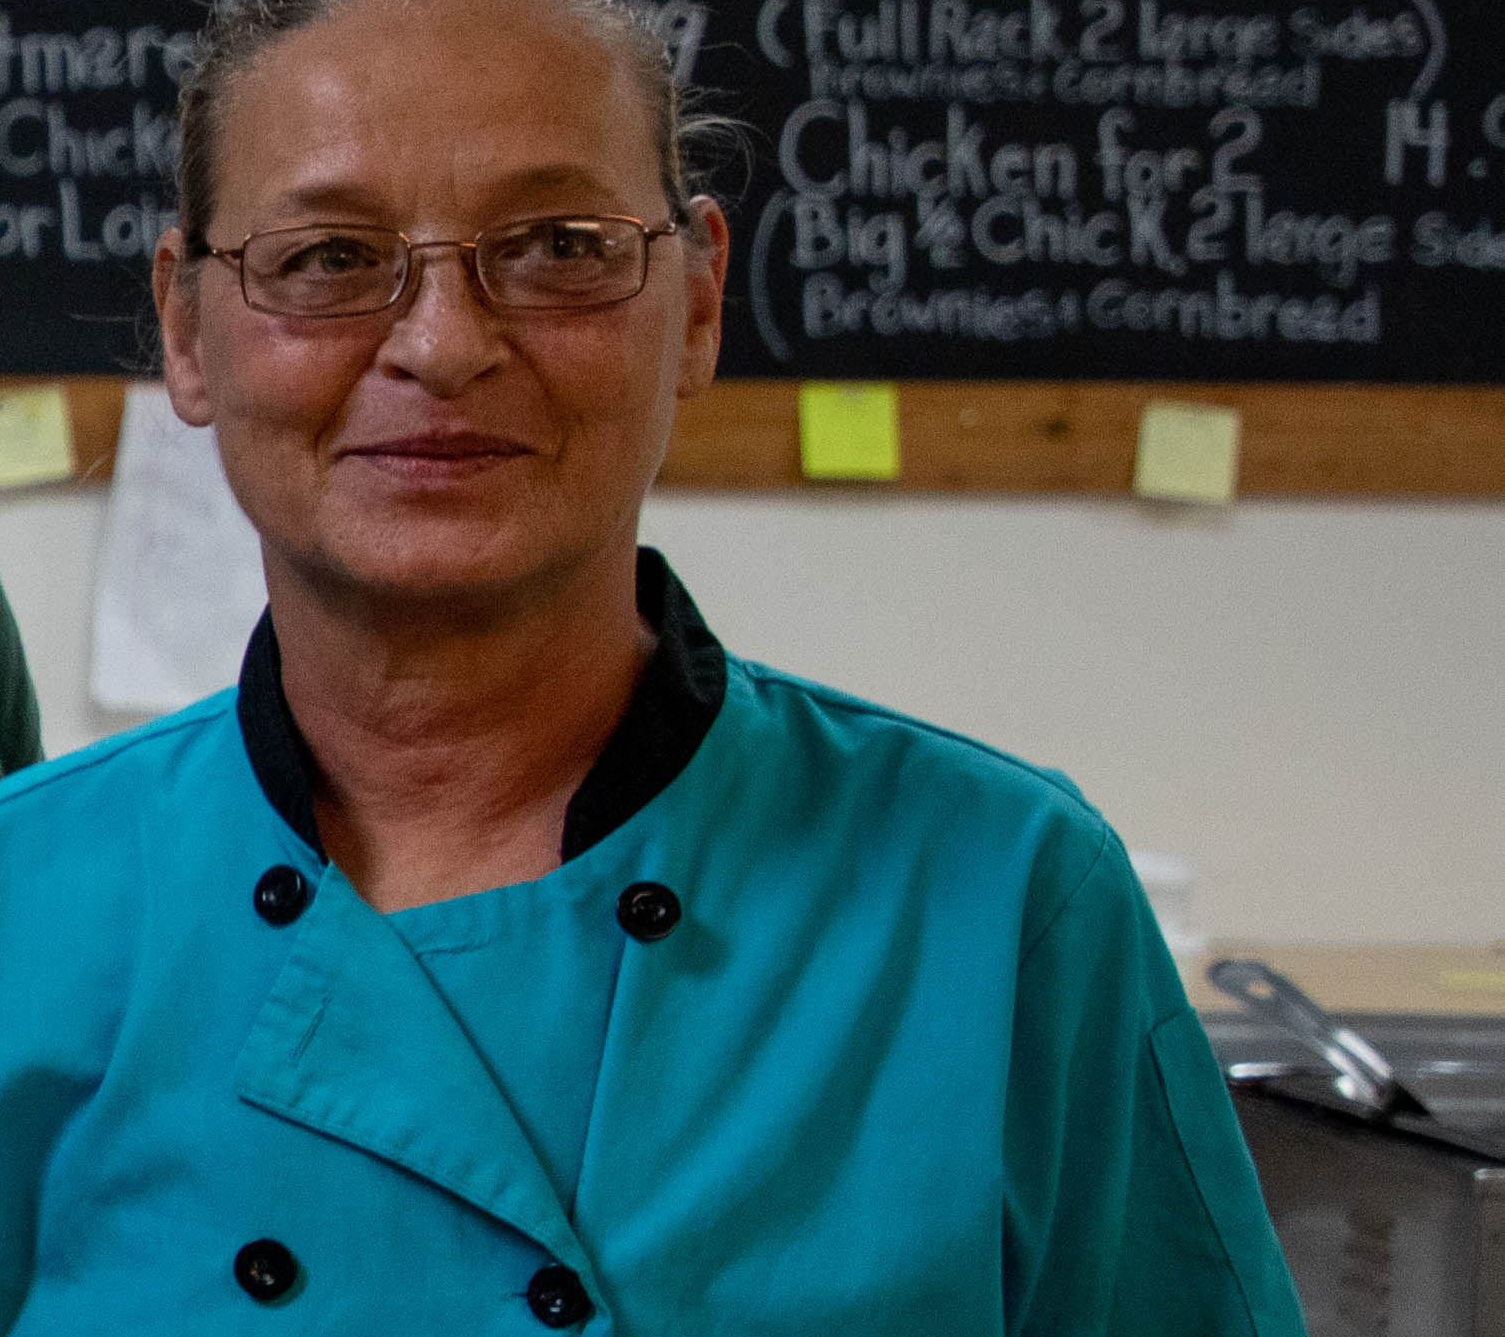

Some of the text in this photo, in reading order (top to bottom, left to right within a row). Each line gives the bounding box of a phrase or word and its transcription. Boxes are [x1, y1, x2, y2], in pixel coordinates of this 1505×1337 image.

[777, 97, 1080, 202] Chicken
[1094, 106, 1204, 203] for
[1207, 105, 1266, 196] 2
[1183, 186, 1235, 264] 2
